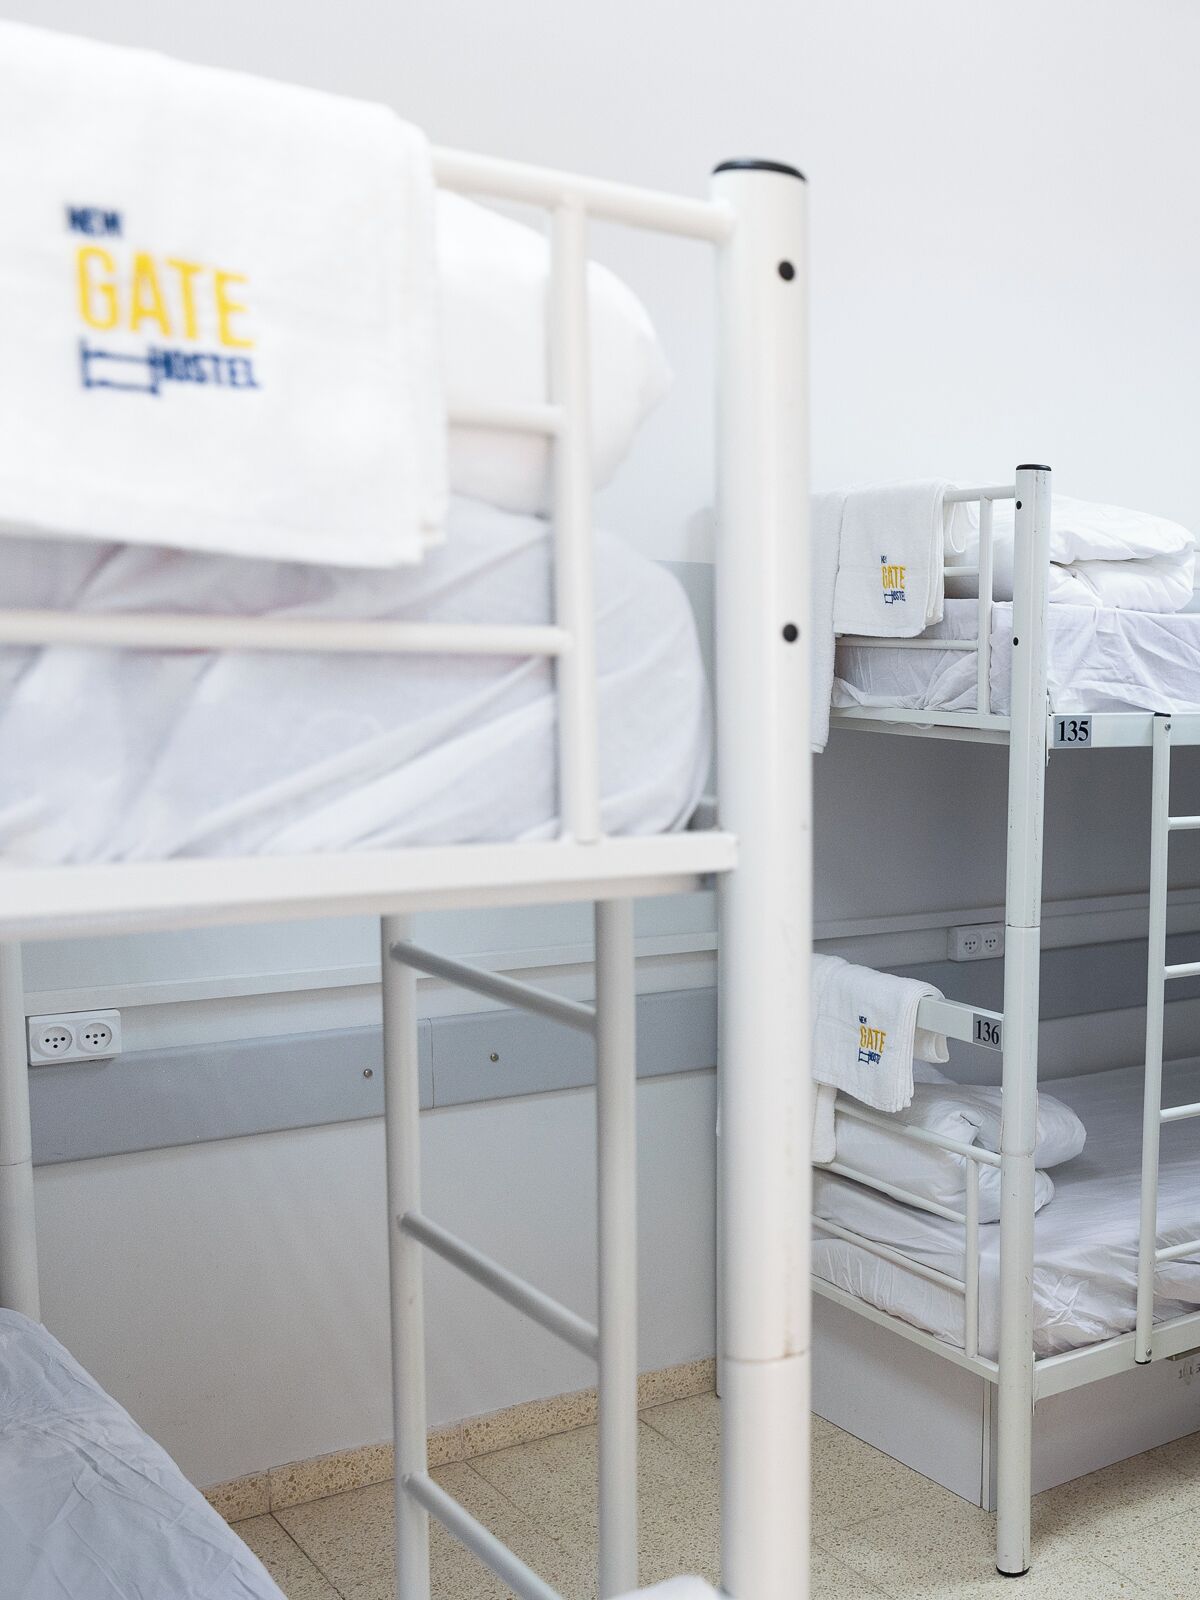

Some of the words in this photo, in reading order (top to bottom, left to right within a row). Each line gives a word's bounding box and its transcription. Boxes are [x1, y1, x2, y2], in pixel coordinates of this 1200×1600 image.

[76, 246, 257, 348] GATE
[881, 566, 906, 589] GATE
[1057, 720, 1089, 742] 135
[859, 1025, 886, 1054] GATE
[975, 1020, 1000, 1045] 136
